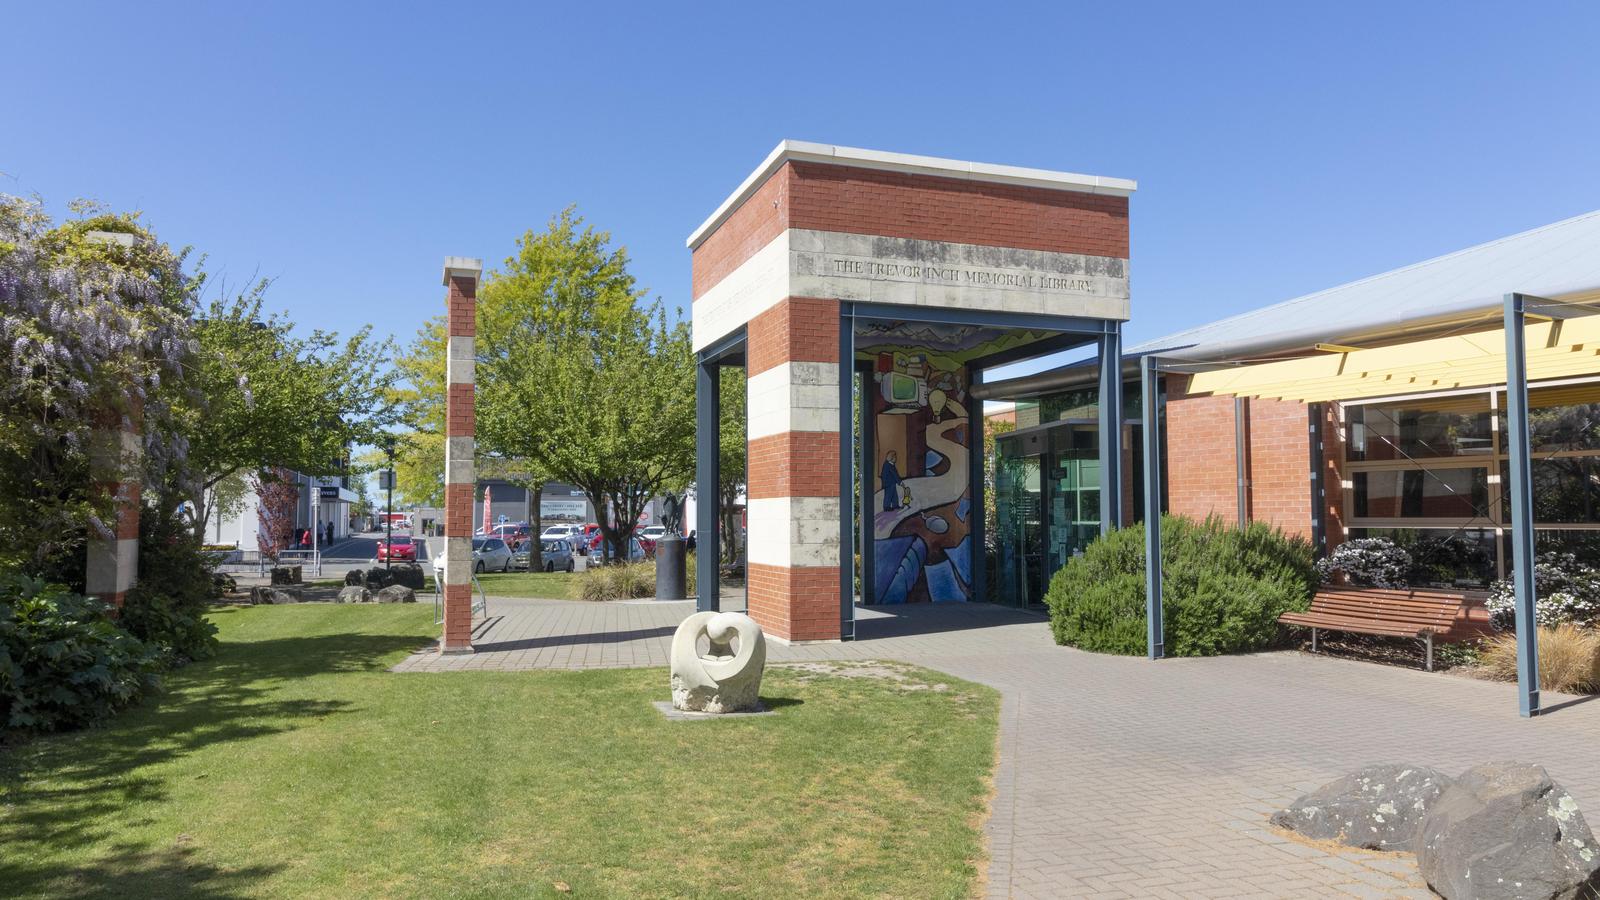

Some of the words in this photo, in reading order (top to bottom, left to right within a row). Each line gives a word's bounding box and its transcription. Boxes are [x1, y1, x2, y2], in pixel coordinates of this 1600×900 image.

[834, 259, 863, 274] THE
[867, 262, 921, 277] TREVOR
[927, 267, 960, 281] INCH
[965, 270, 1037, 288] MEMORIAL
[1040, 276, 1093, 292] LIBRARY
